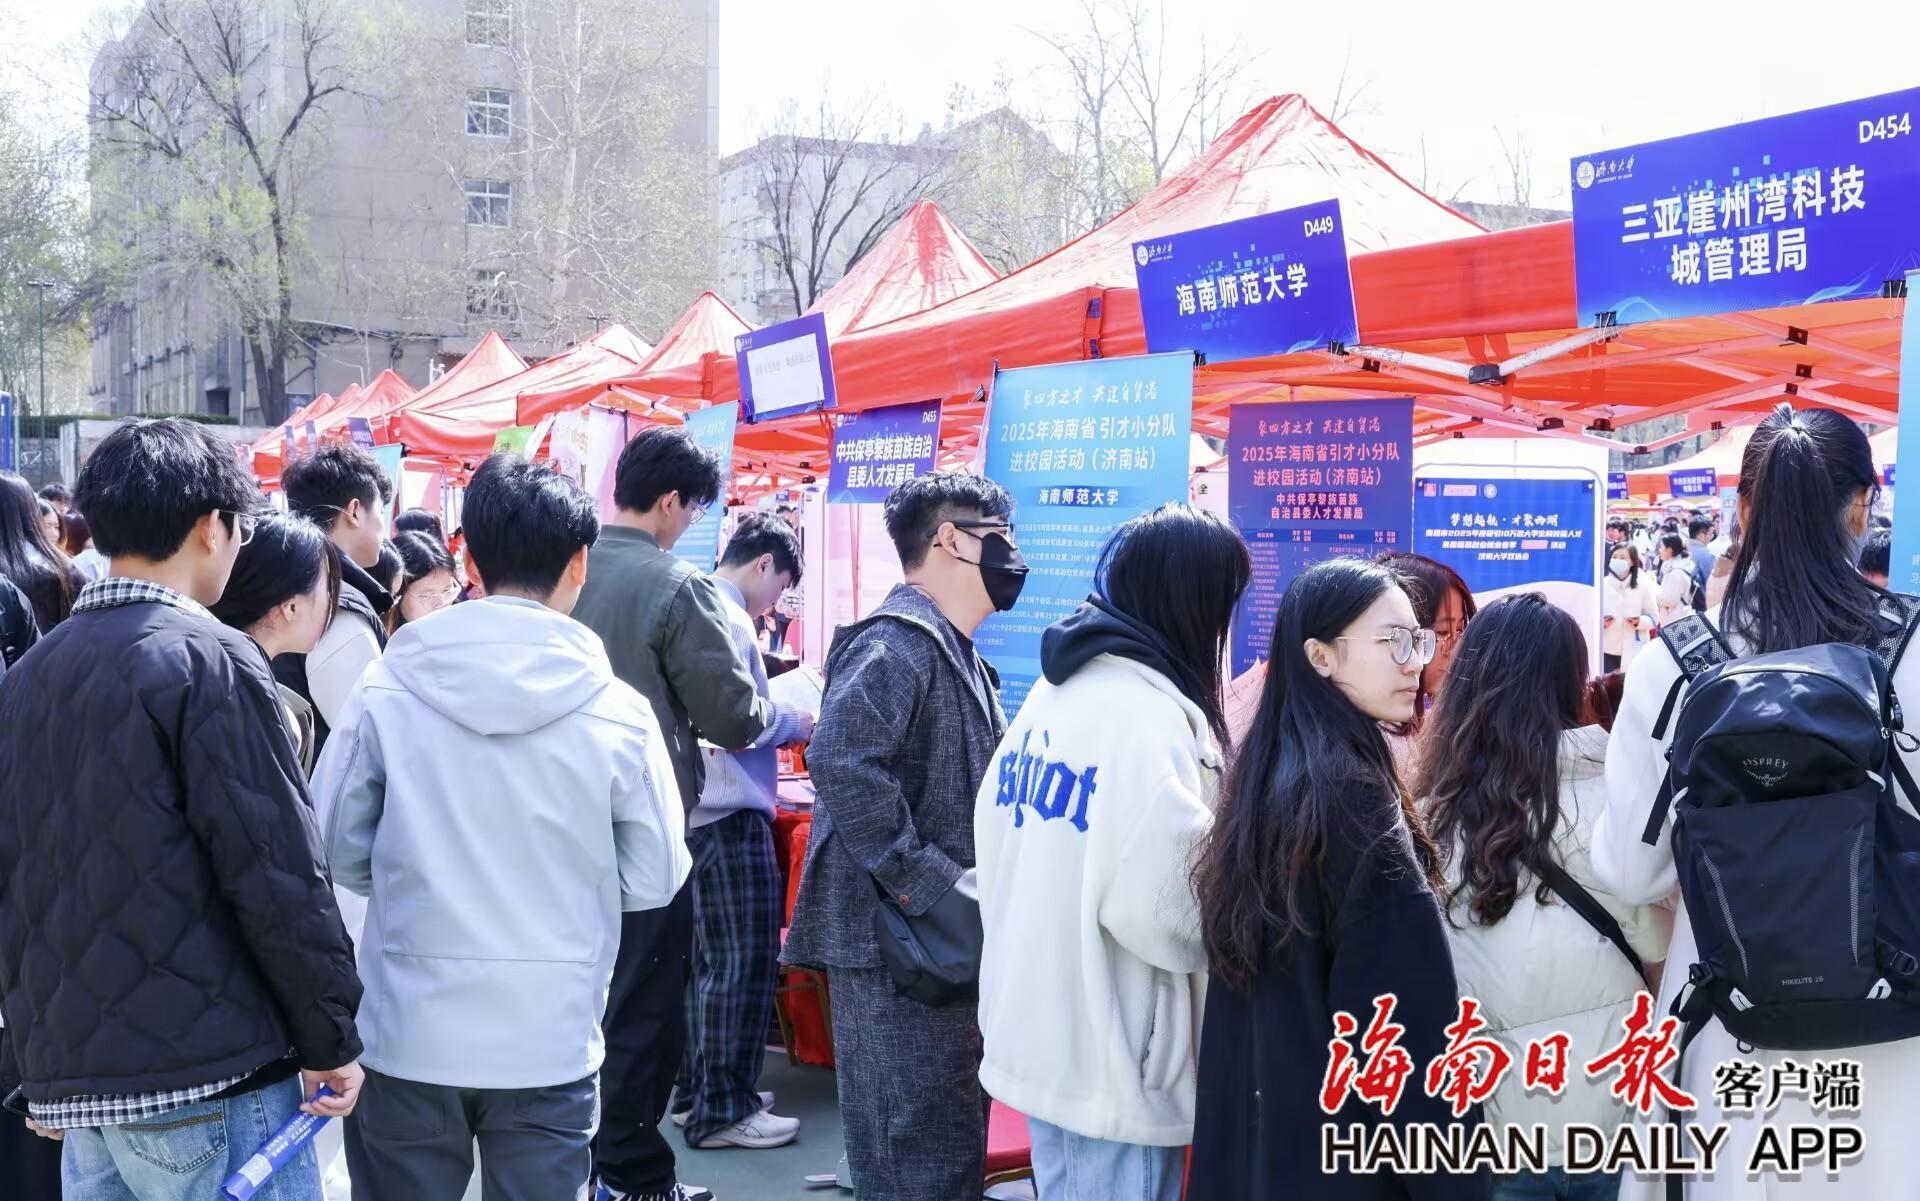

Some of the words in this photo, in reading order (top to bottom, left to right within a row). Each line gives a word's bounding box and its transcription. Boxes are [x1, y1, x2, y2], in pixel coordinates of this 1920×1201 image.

[1858, 112, 1912, 143] D454
[1621, 164, 1866, 243] 三亚崖州湾科技
[1303, 215, 1334, 238] D449
[1671, 228, 1808, 286] 城管理局
[1175, 263, 1309, 316] 海南师范大学
[922, 410, 937, 424] D455
[835, 433, 933, 464] 中共保亭黎族苗族自治
[1241, 442, 1400, 462] 2025年海南省引才小分队
[1009, 447, 1158, 473] 进校园活动（济南站）
[1252, 466, 1383, 487] 进校园活动（济南站）
[1038, 488, 1120, 506] 海南师范大学
[1276, 492, 1359, 506] 中共保亭黎族苗族
[1271, 506, 1364, 520] 自治县委人才发展局
[1743, 757, 1790, 770] OSPREY
